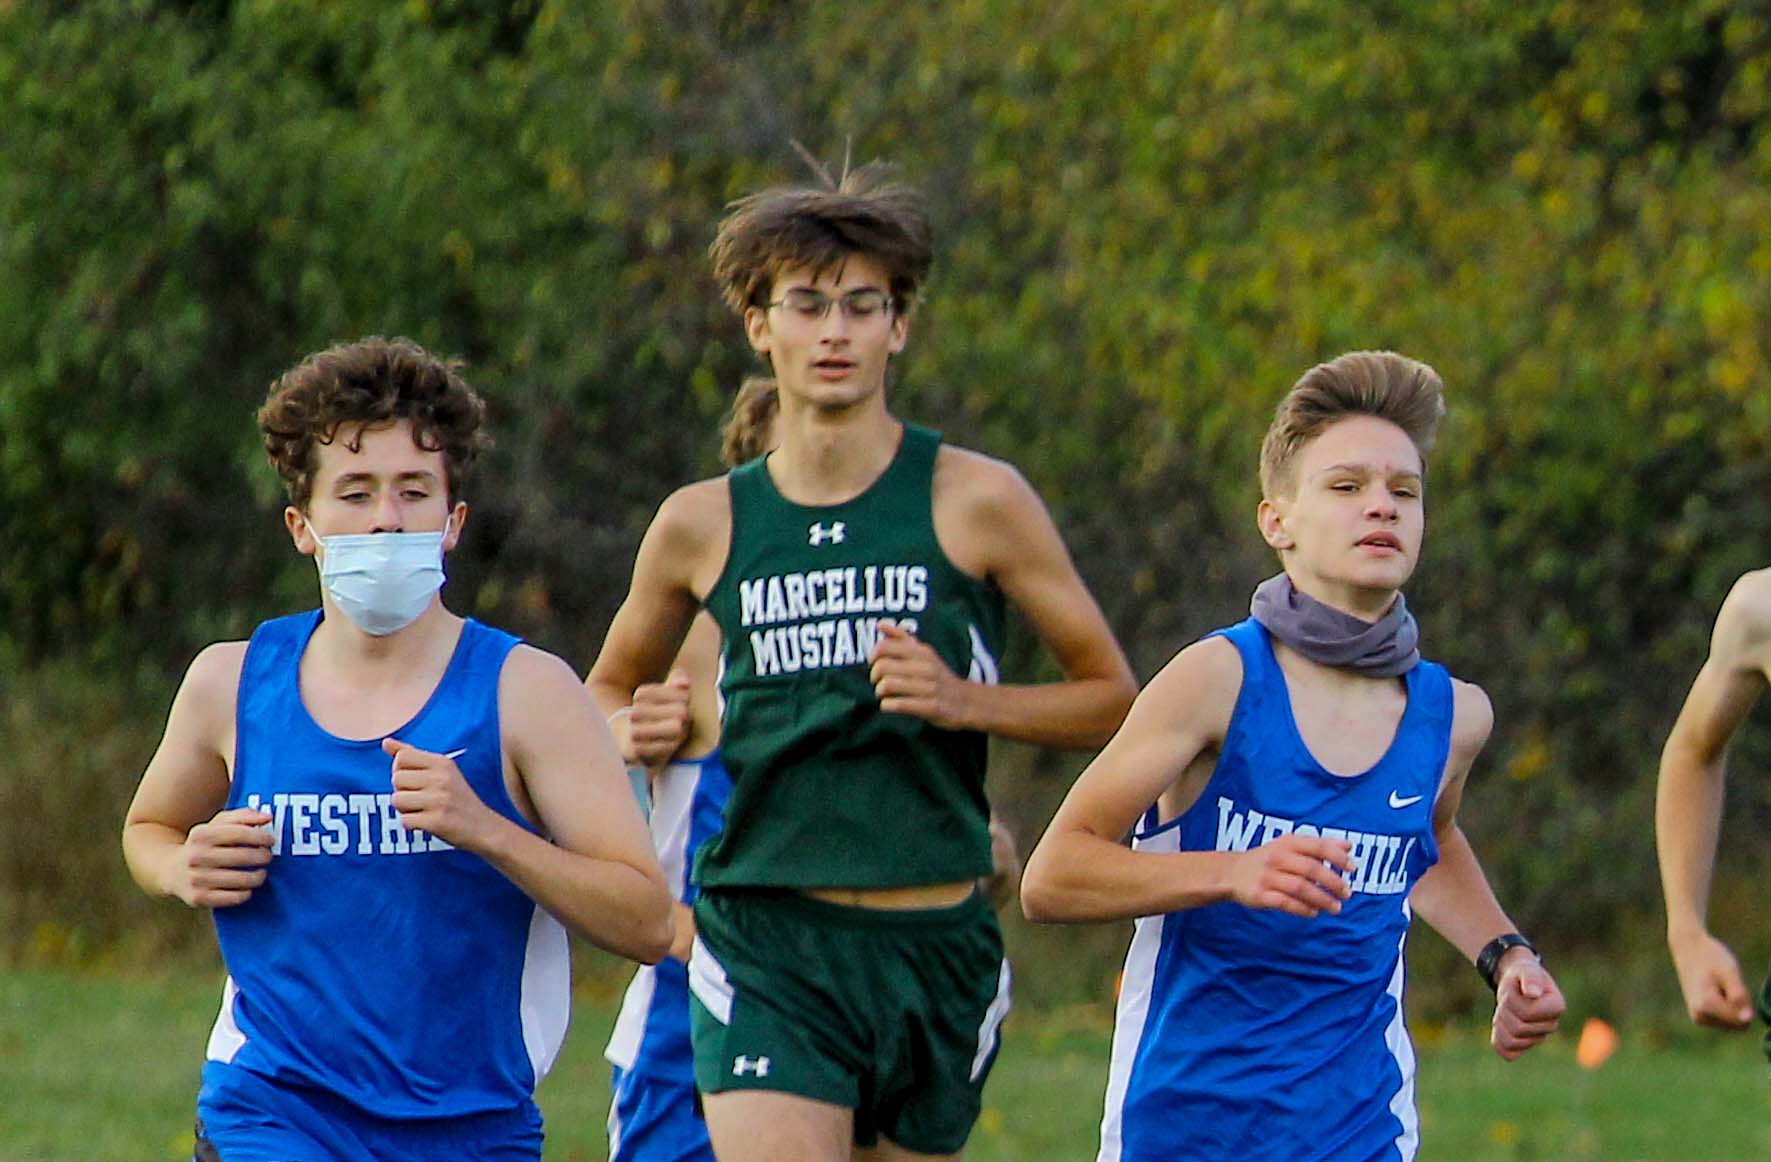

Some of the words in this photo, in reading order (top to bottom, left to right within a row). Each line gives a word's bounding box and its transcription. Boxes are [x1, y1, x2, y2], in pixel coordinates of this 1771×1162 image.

[739, 565, 928, 627] MARCELLUS
[247, 793, 455, 857] WESTH
[1215, 796, 1417, 895] WHILL
